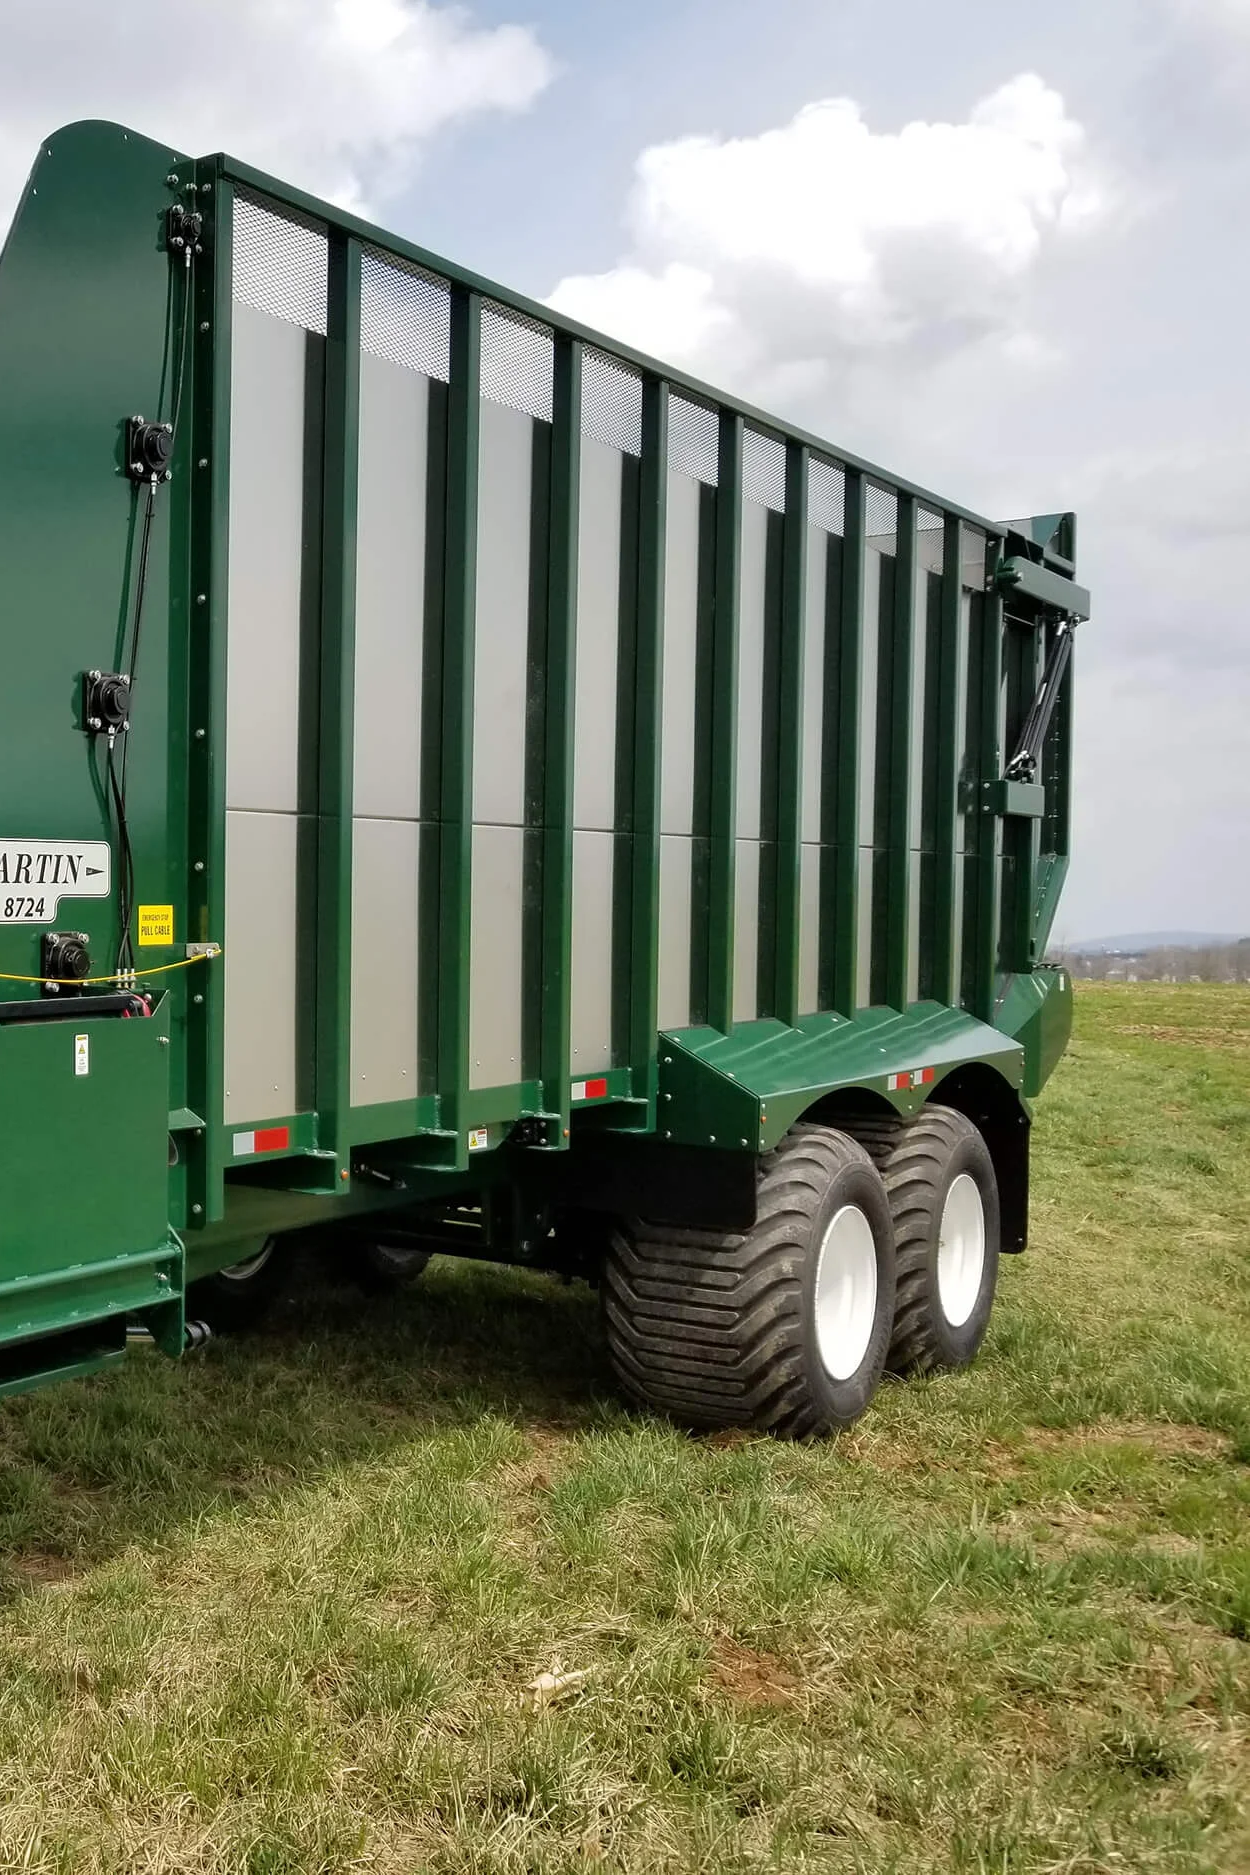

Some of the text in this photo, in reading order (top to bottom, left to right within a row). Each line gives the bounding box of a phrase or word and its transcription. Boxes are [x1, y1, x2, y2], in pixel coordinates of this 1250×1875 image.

[4, 897, 45, 917] 8724
[141, 924, 170, 936] PULL CABLE
